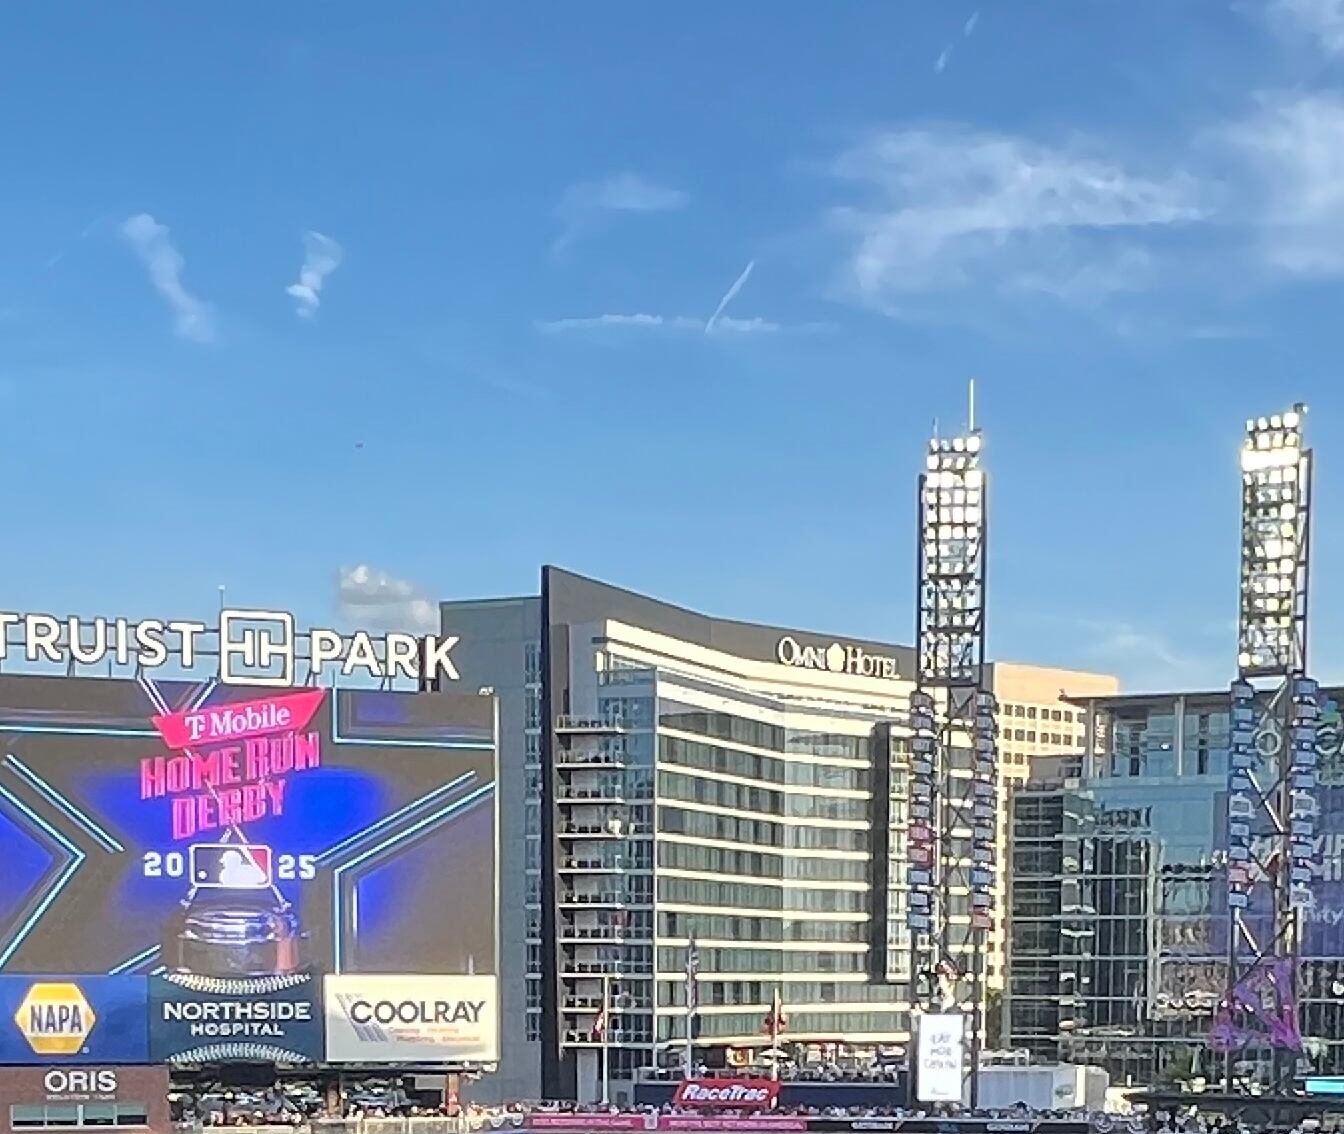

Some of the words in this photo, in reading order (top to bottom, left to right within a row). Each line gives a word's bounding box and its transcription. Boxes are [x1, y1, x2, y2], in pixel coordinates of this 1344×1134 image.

[311, 630, 460, 680] PARK
[776, 636, 827, 670] OMNI
[847, 650, 900, 679] HOTEL
[210, 704, 291, 737] Mobile
[140, 747, 242, 799] HOME
[244, 731, 320, 780] RUN
[172, 779, 287, 840] DERBY
[143, 852, 184, 878] 20
[278, 854, 316, 880] 25
[30, 1004, 83, 1035] NAPA
[164, 1002, 311, 1020] NORTHSIDE
[351, 1000, 486, 1024] COOLRAY
[191, 1024, 284, 1037] HOSPITAL
[44, 1070, 117, 1092] ORIS
[682, 1083, 770, 1101] RaceTrac
